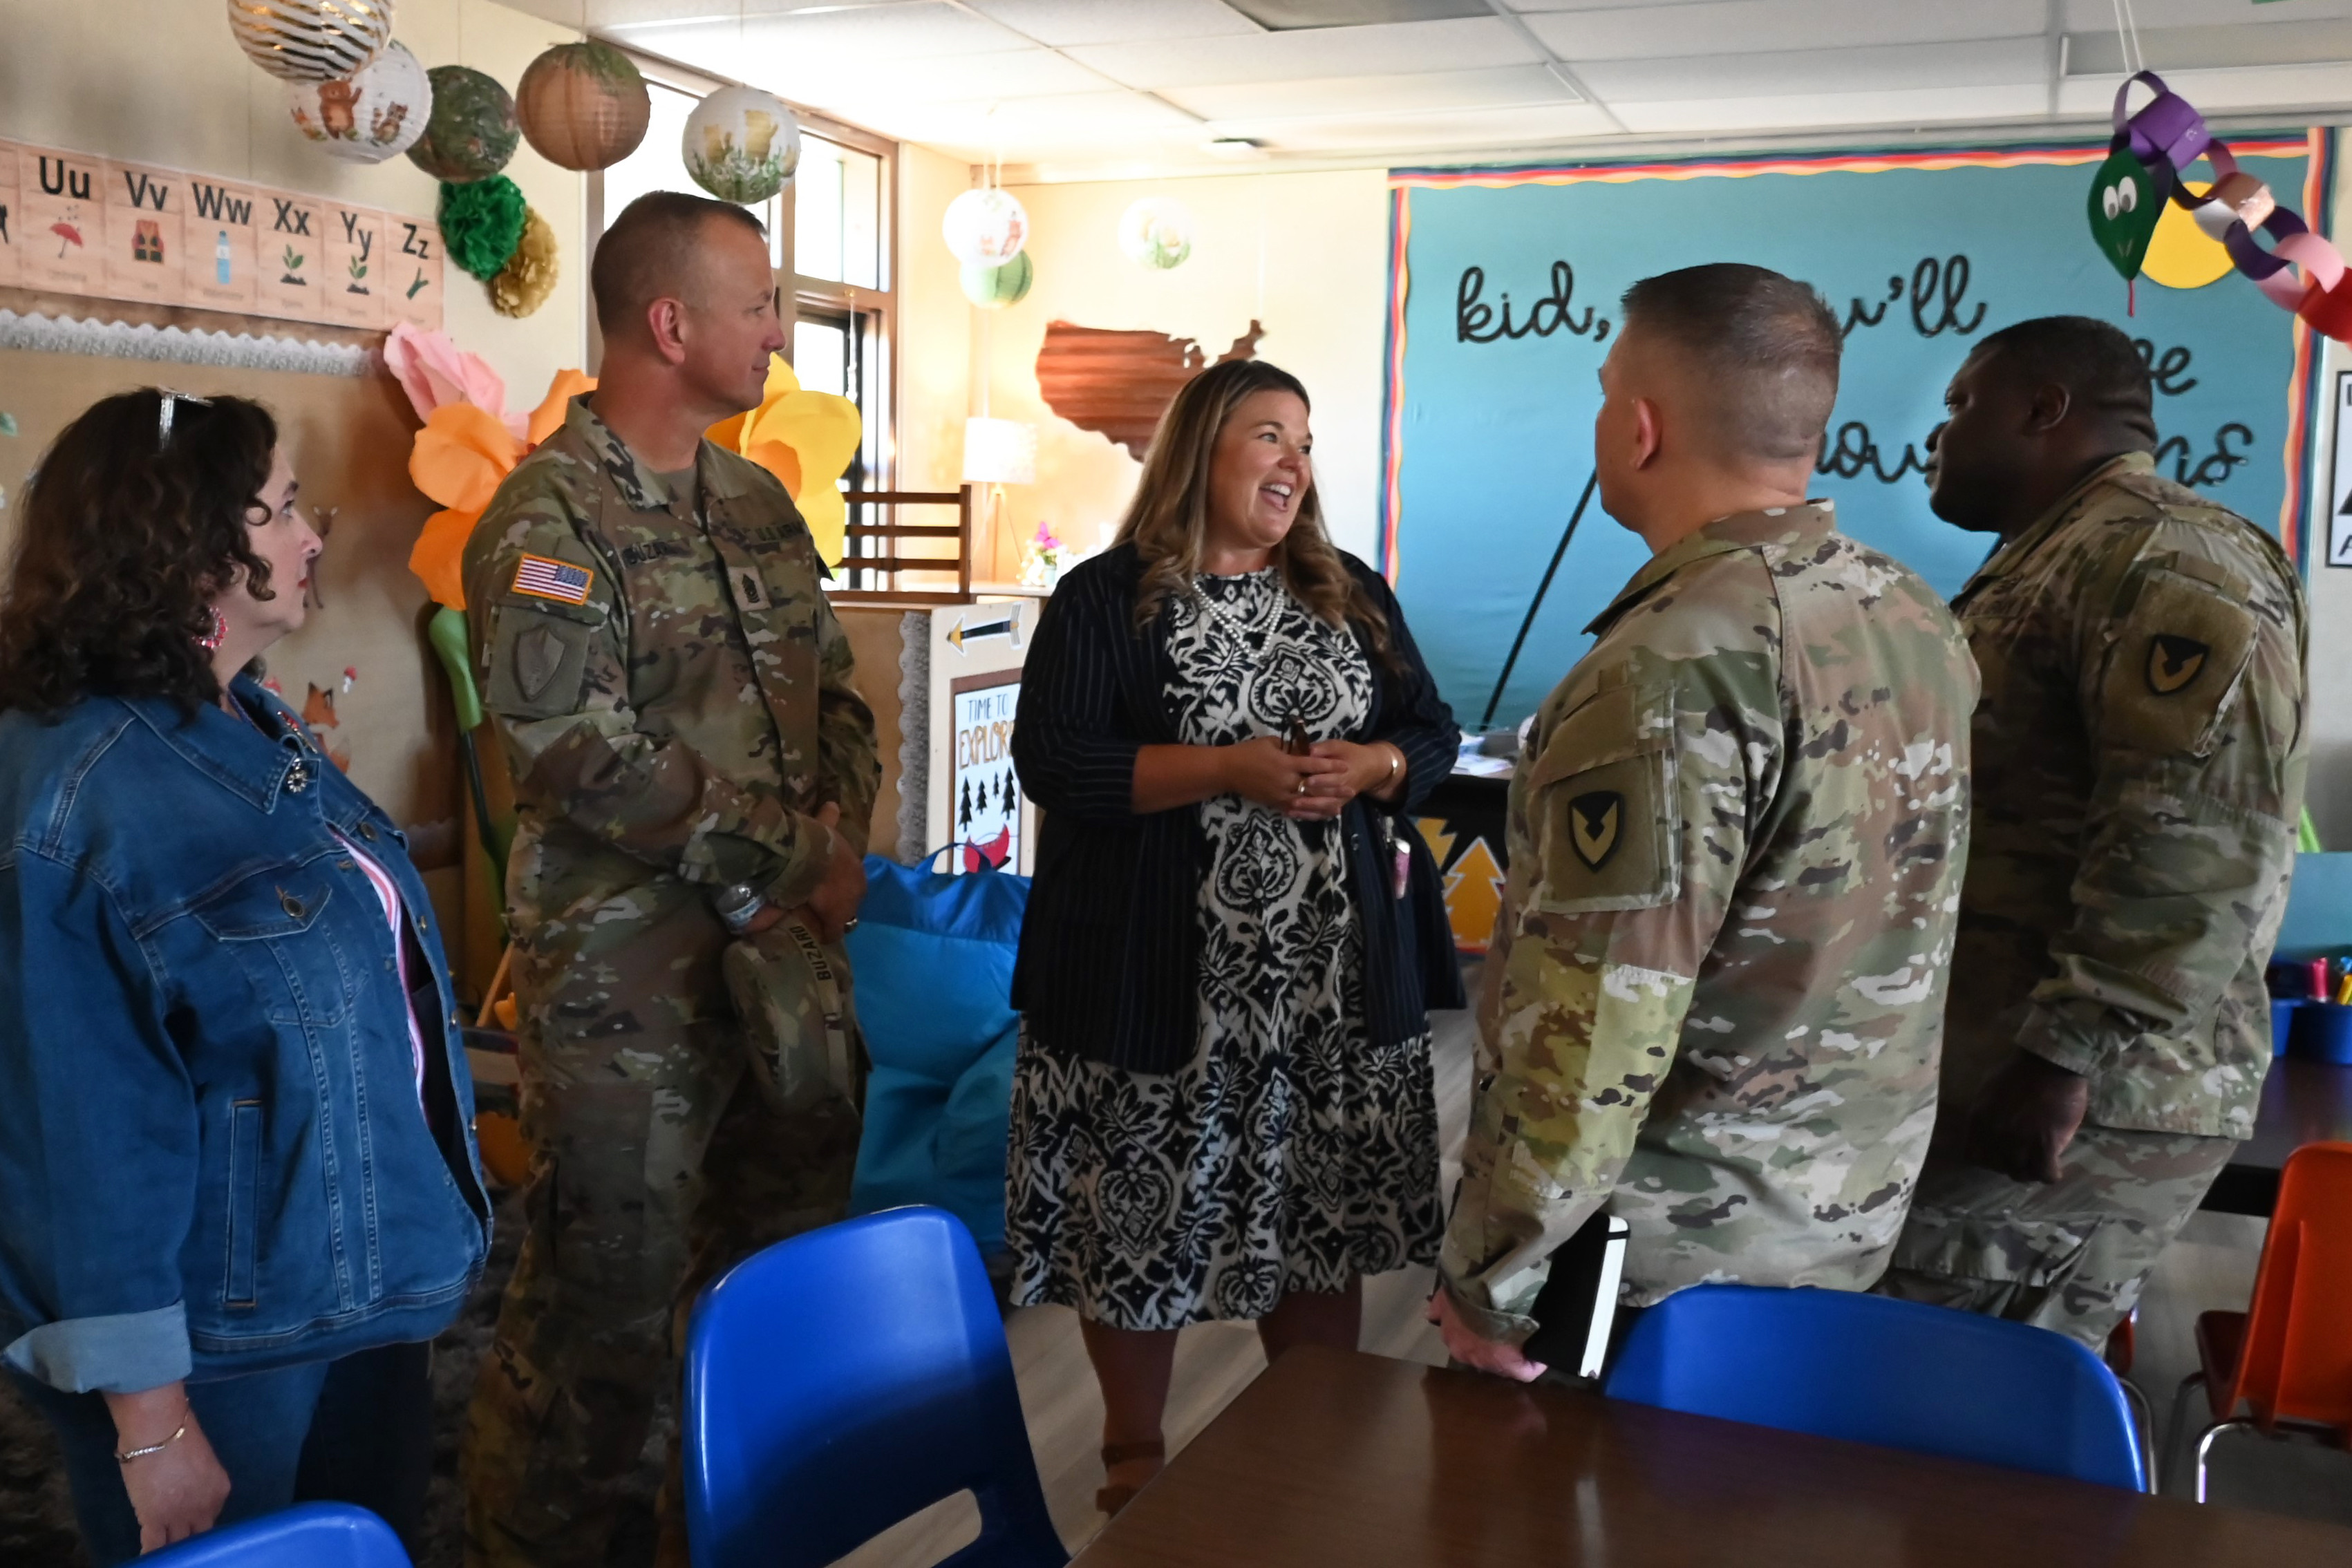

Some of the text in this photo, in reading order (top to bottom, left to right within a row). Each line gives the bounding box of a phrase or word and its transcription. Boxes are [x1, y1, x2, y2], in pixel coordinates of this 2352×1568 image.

[39, 156, 91, 200] Uu
[124, 171, 168, 211] Vv
[191, 182, 252, 225] Ww
[273, 198, 310, 236] Xx
[340, 210, 373, 262] Yy
[402, 223, 429, 259] Zz
[1457, 261, 1610, 343] kid,
[968, 694, 1008, 722] TIME TO
